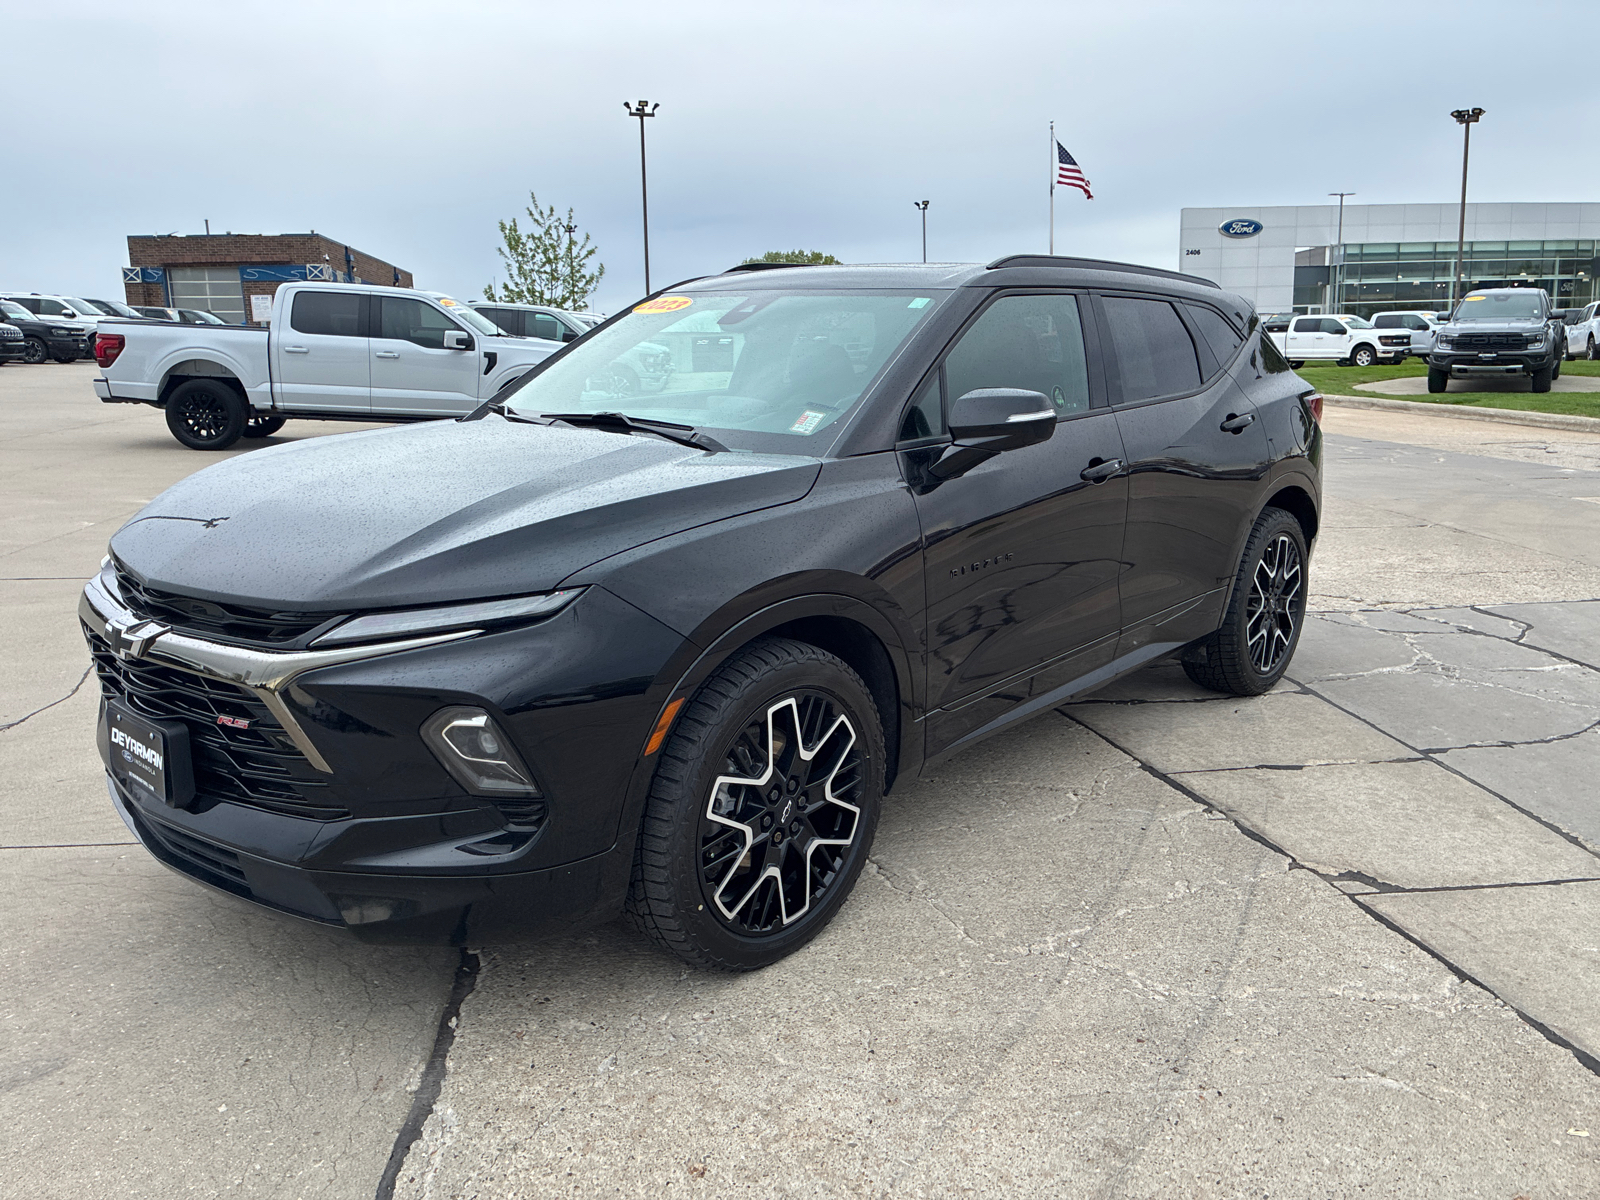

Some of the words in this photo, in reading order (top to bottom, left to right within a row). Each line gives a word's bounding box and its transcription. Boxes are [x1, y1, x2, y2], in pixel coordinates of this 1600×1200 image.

[1229, 221, 1255, 234] Ford
[638, 300, 689, 311] 2023
[217, 715, 249, 730] RS
[111, 726, 163, 771] DEYARMAN
